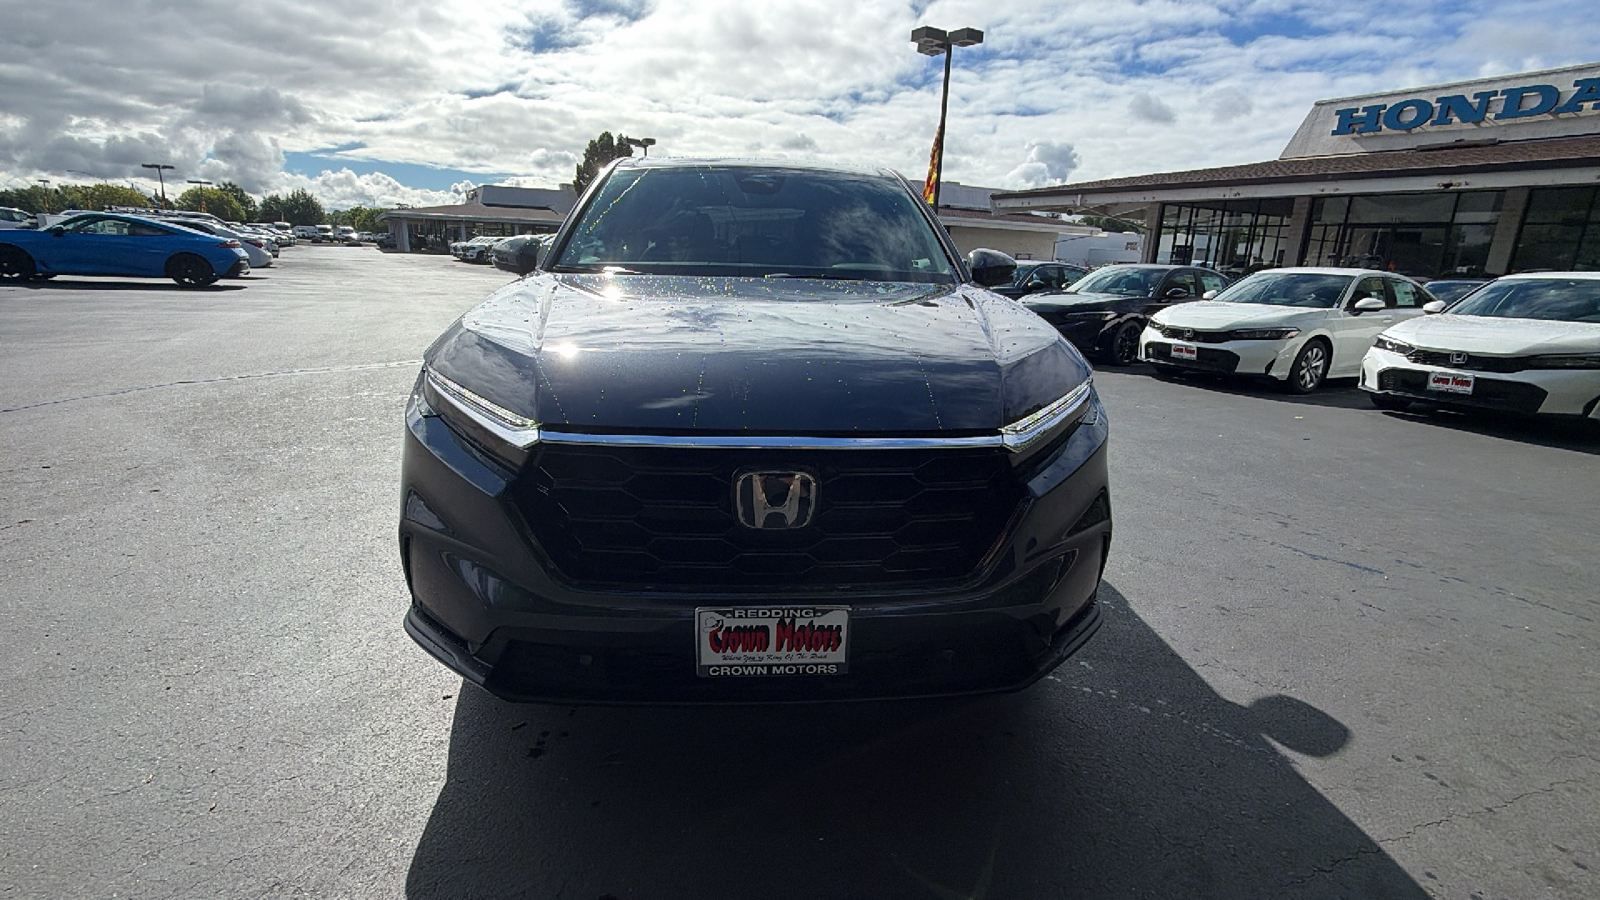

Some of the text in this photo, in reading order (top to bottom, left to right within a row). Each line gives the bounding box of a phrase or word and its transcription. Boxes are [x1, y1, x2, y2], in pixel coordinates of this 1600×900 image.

[1331, 77, 1600, 136] HONDA
[734, 609, 814, 618] REDDING
[709, 618, 842, 653] Crown Motors
[721, 654, 742, 662] Where
[766, 654, 783, 662] King
[784, 653, 794, 661] Of
[709, 664, 838, 676] CROWN MOTORS
